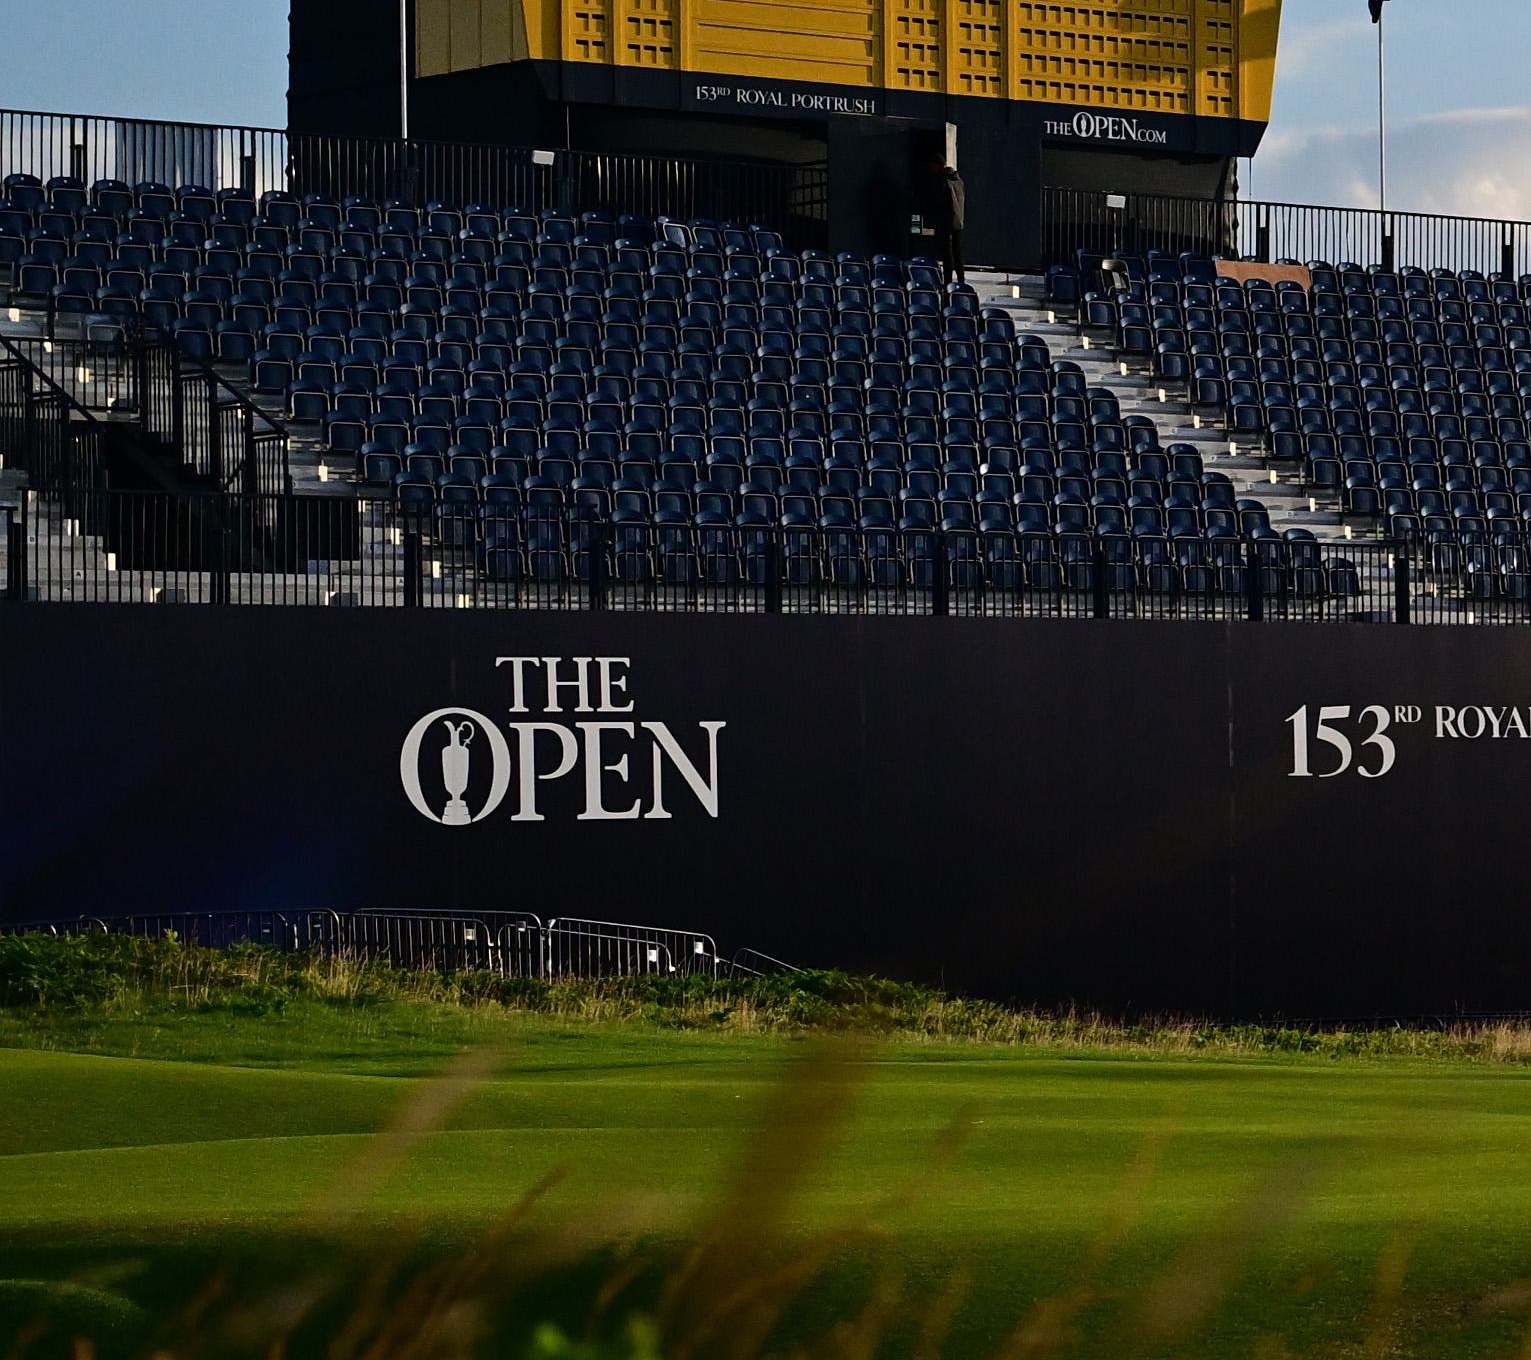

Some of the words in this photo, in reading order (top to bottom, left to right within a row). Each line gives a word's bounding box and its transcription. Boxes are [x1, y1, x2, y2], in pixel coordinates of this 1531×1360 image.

[696, 86, 731, 101] 153RD
[736, 88, 787, 107] ROYAL
[792, 93, 875, 114] PORTRUSH
[495, 656, 635, 713] THE
[400, 706, 727, 826] OPEN
[1284, 704, 1422, 778] 153RD
